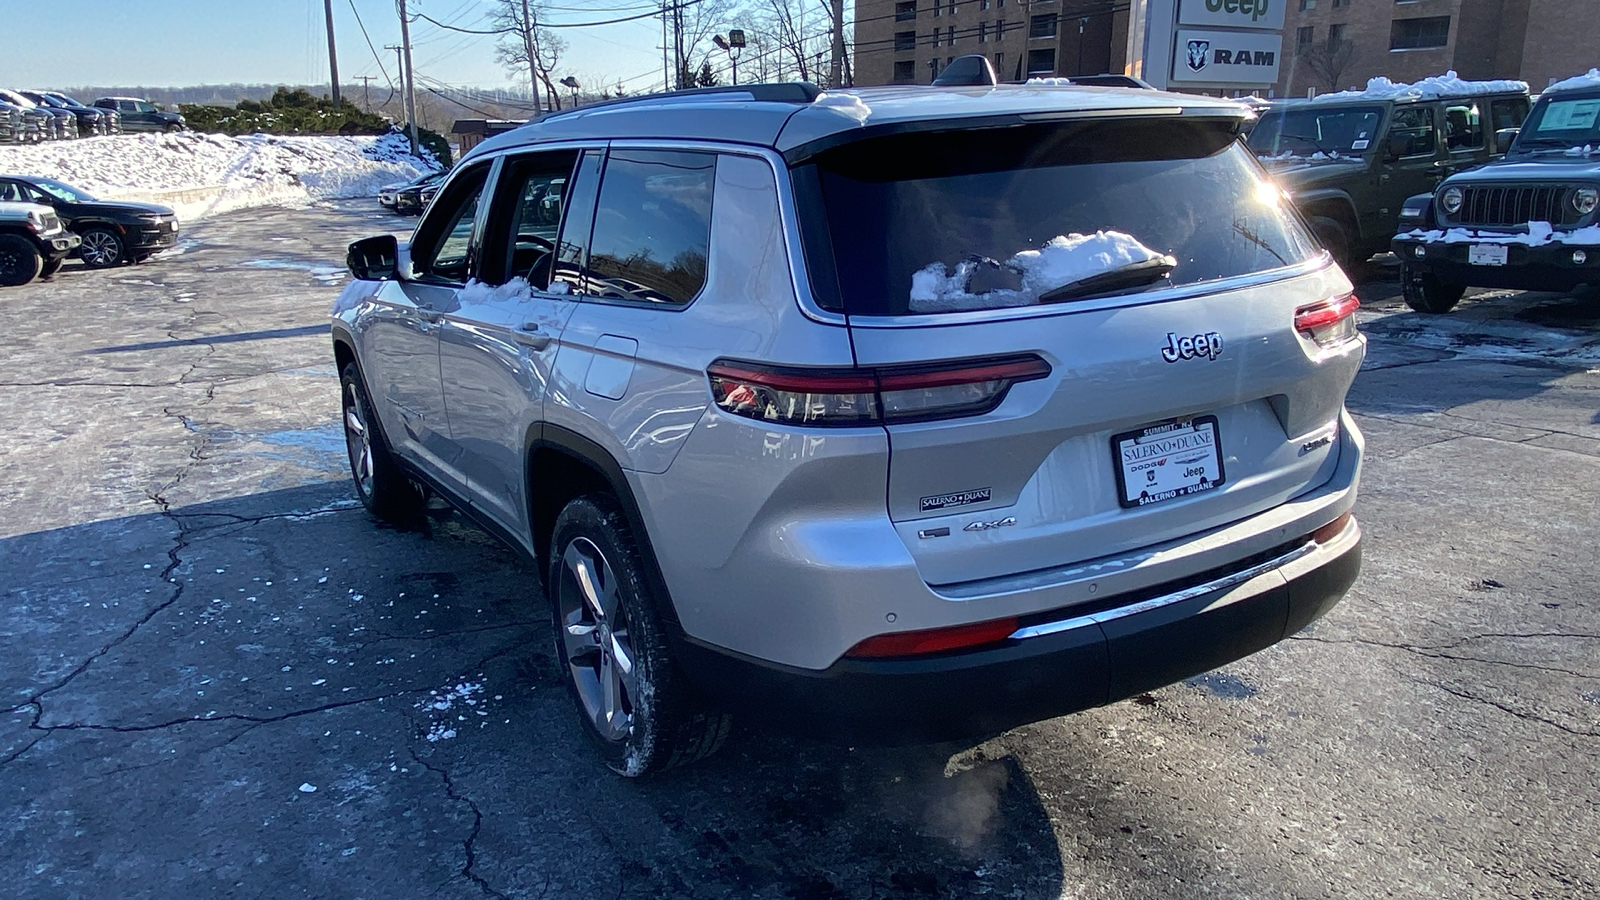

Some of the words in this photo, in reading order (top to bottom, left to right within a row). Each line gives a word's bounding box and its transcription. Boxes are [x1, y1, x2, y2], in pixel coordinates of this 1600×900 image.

[1214, 49, 1275, 66] RAM
[1162, 331, 1224, 363] Jeep
[1181, 420, 1193, 429] NJ
[1124, 441, 1172, 462] SALERNO
[1177, 431, 1212, 450] DUANE
[1183, 466, 1205, 478] Jeep
[923, 496, 957, 507] SALERNO
[964, 490, 990, 501] DUANE
[1139, 491, 1176, 505] SALERNO
[1187, 481, 1214, 493] DUANE
